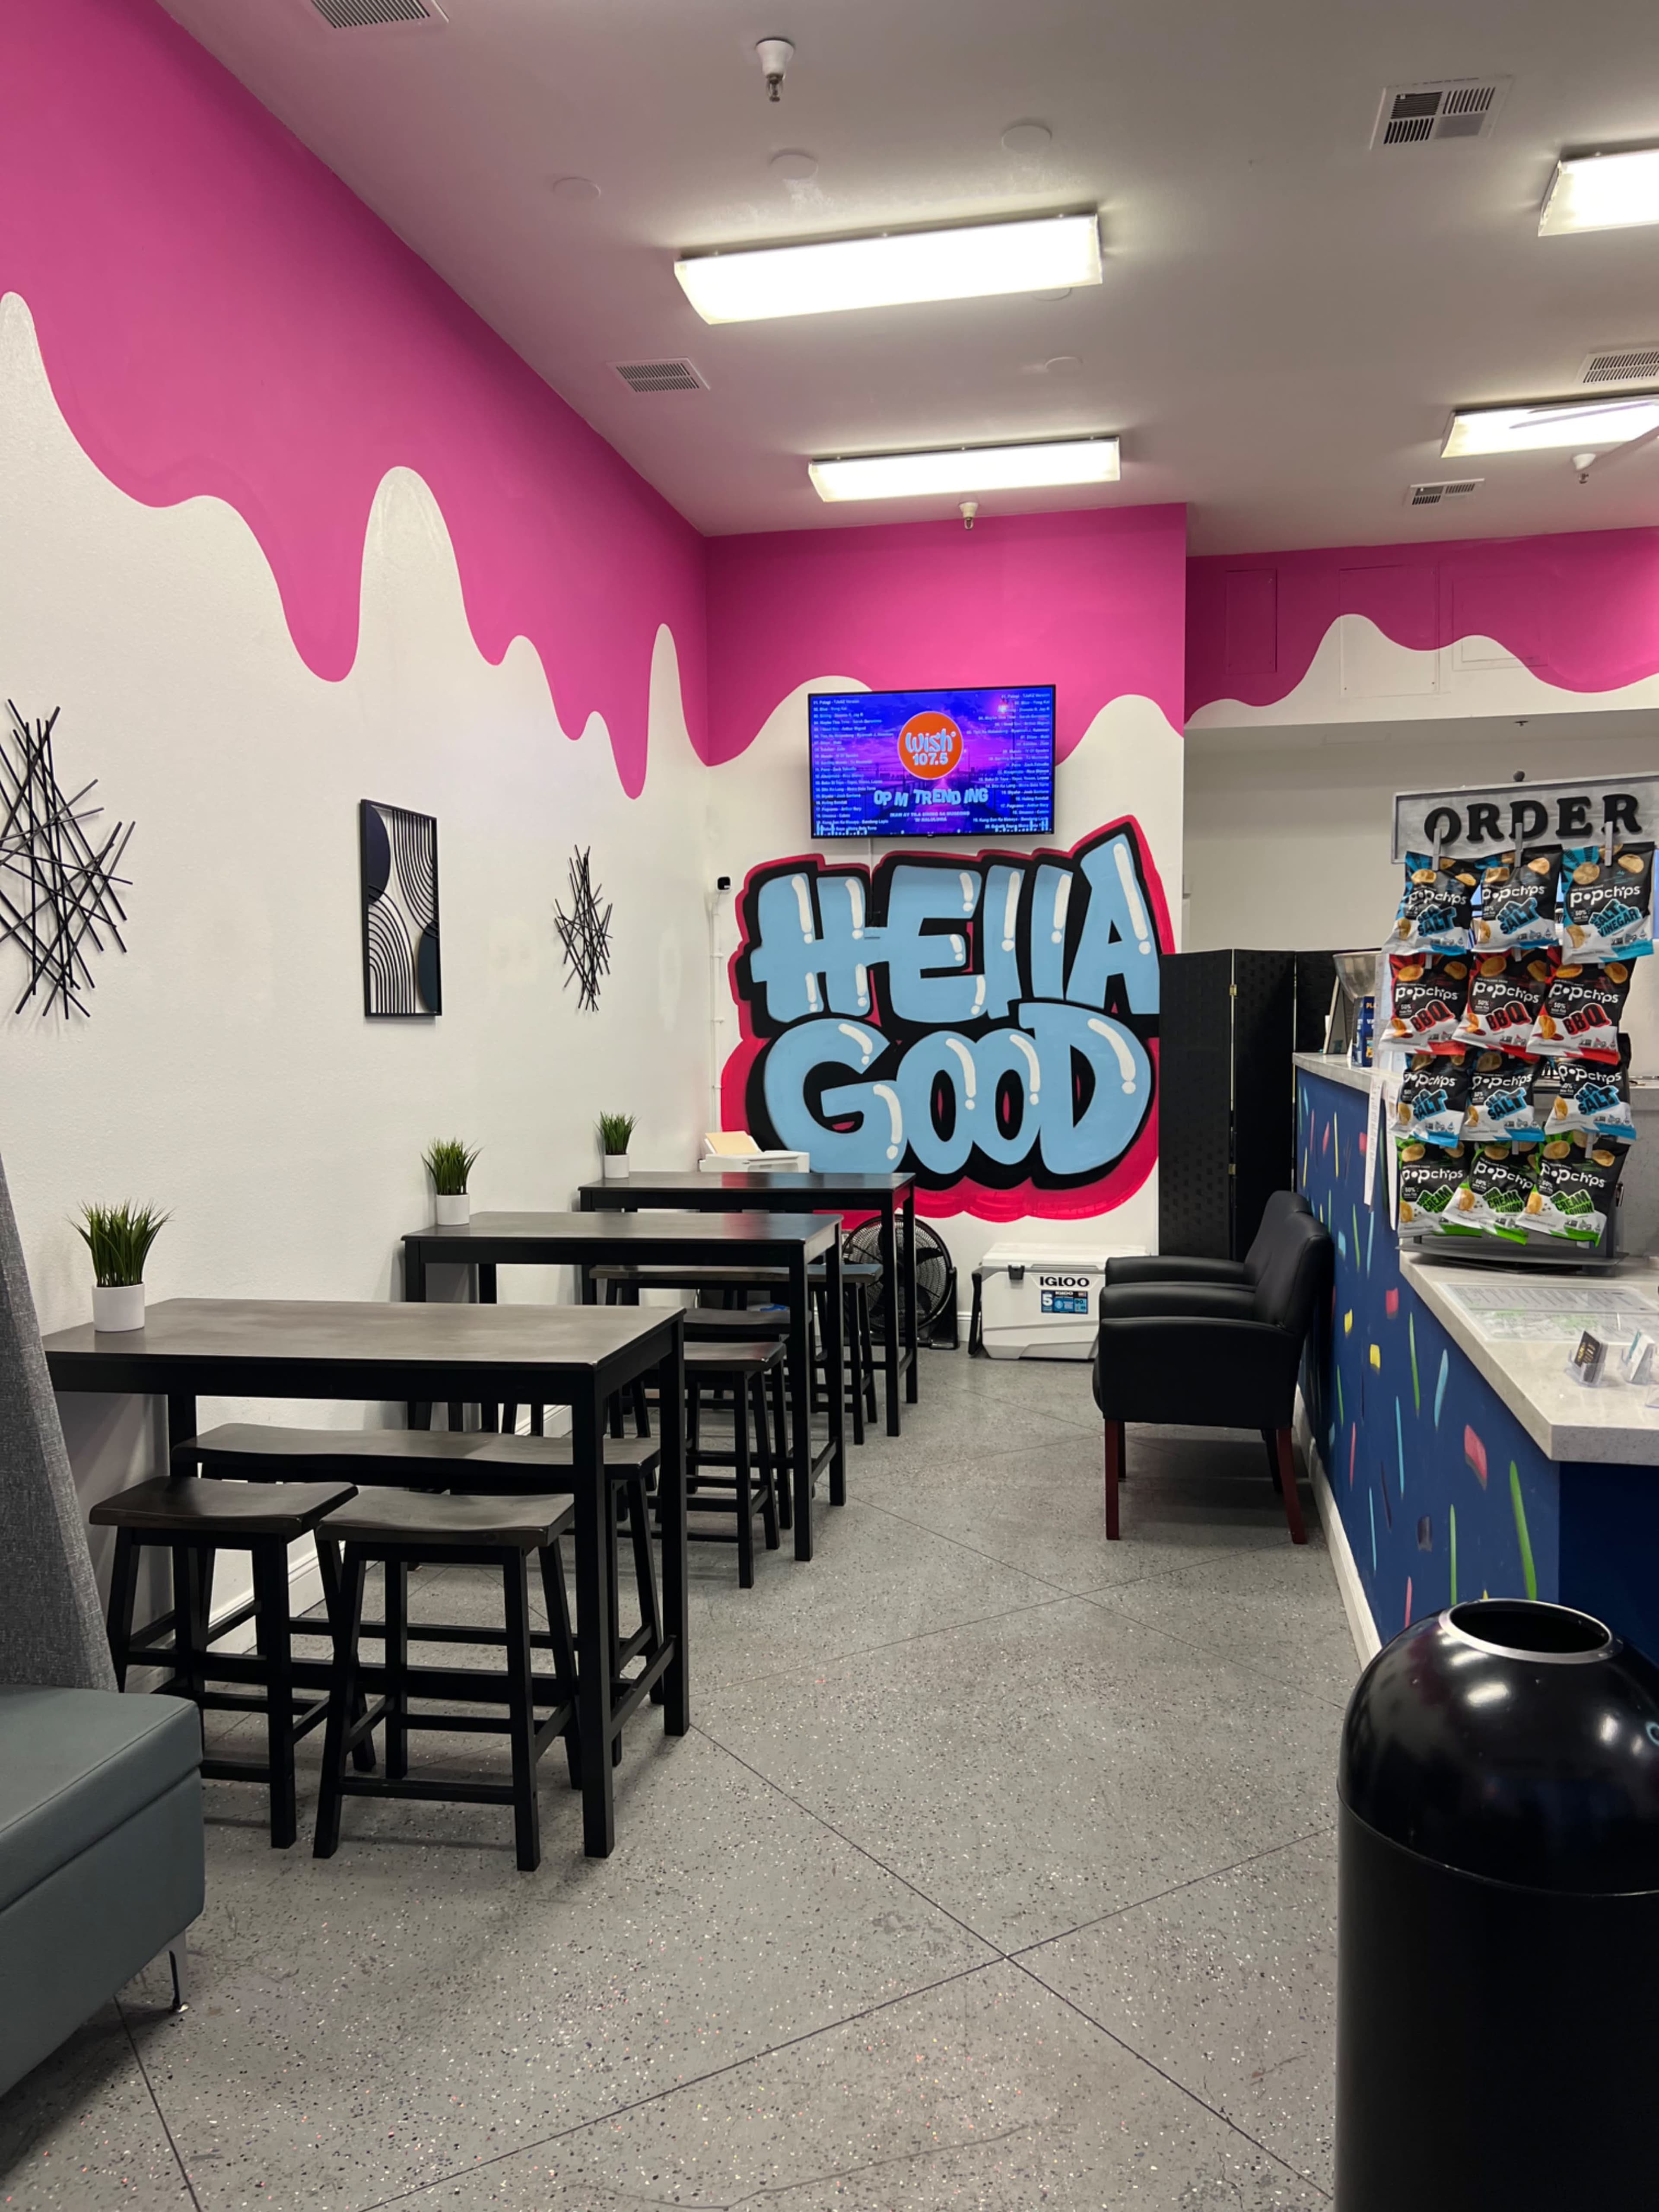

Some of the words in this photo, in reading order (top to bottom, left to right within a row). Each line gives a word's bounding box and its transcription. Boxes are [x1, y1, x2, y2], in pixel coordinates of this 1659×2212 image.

[913, 753, 948, 766] 107.5
[1424, 794, 1642, 845] ORDER
[1570, 886, 1640, 908] popchips
[1417, 908, 1453, 936] SALT
[1500, 900, 1536, 934] SALT
[1594, 900, 1620, 929] SALT
[1598, 908, 1639, 937] VINEGAR
[1395, 986, 1458, 1003] popchips
[1472, 981, 1539, 1004] popchips
[1548, 983, 1619, 1004] popchips
[1410, 1001, 1453, 1032] BBQ
[1485, 1002, 1529, 1031] BBQ
[1562, 1004, 1608, 1035] BBQ
[757, 999, 1157, 1179] GOOD
[1576, 1083, 1598, 1102] SEA
[1578, 1087, 1616, 1115] SALT
[1413, 1090, 1444, 1120] SALT
[1487, 1090, 1522, 1120] SALT
[1473, 1161, 1533, 1189] popchip
[1555, 1190, 1591, 1212] CREAM
[1040, 1276, 1090, 1287] IGLOO
[1042, 1293, 1053, 1306] 5
